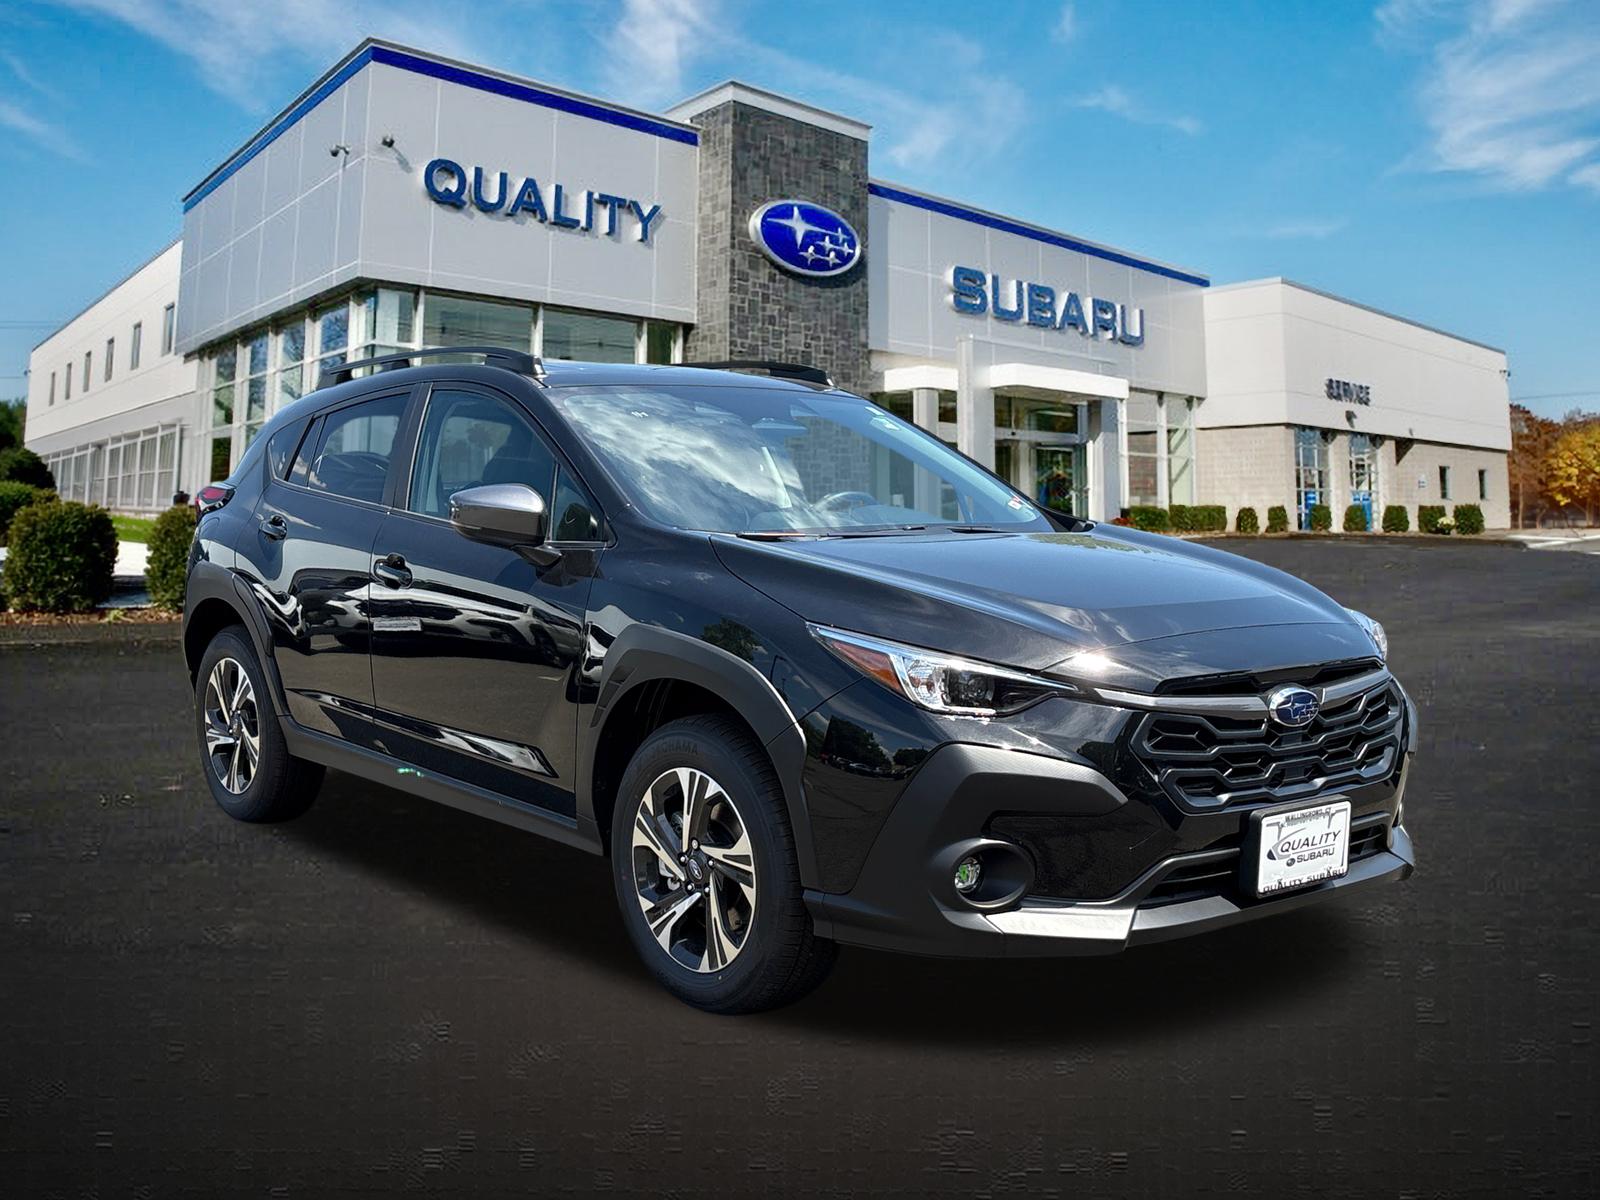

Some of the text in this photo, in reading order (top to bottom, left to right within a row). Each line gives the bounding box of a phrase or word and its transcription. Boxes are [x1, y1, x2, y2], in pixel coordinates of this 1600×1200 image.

[424, 158, 661, 243] QUALITY
[952, 265, 1144, 347] SUBARU
[1325, 378, 1370, 406] SERVICE
[1280, 830, 1341, 853] QUALITY
[1296, 847, 1335, 863] SUBARU
[1263, 868, 1345, 892] QUALITY SUBARU
